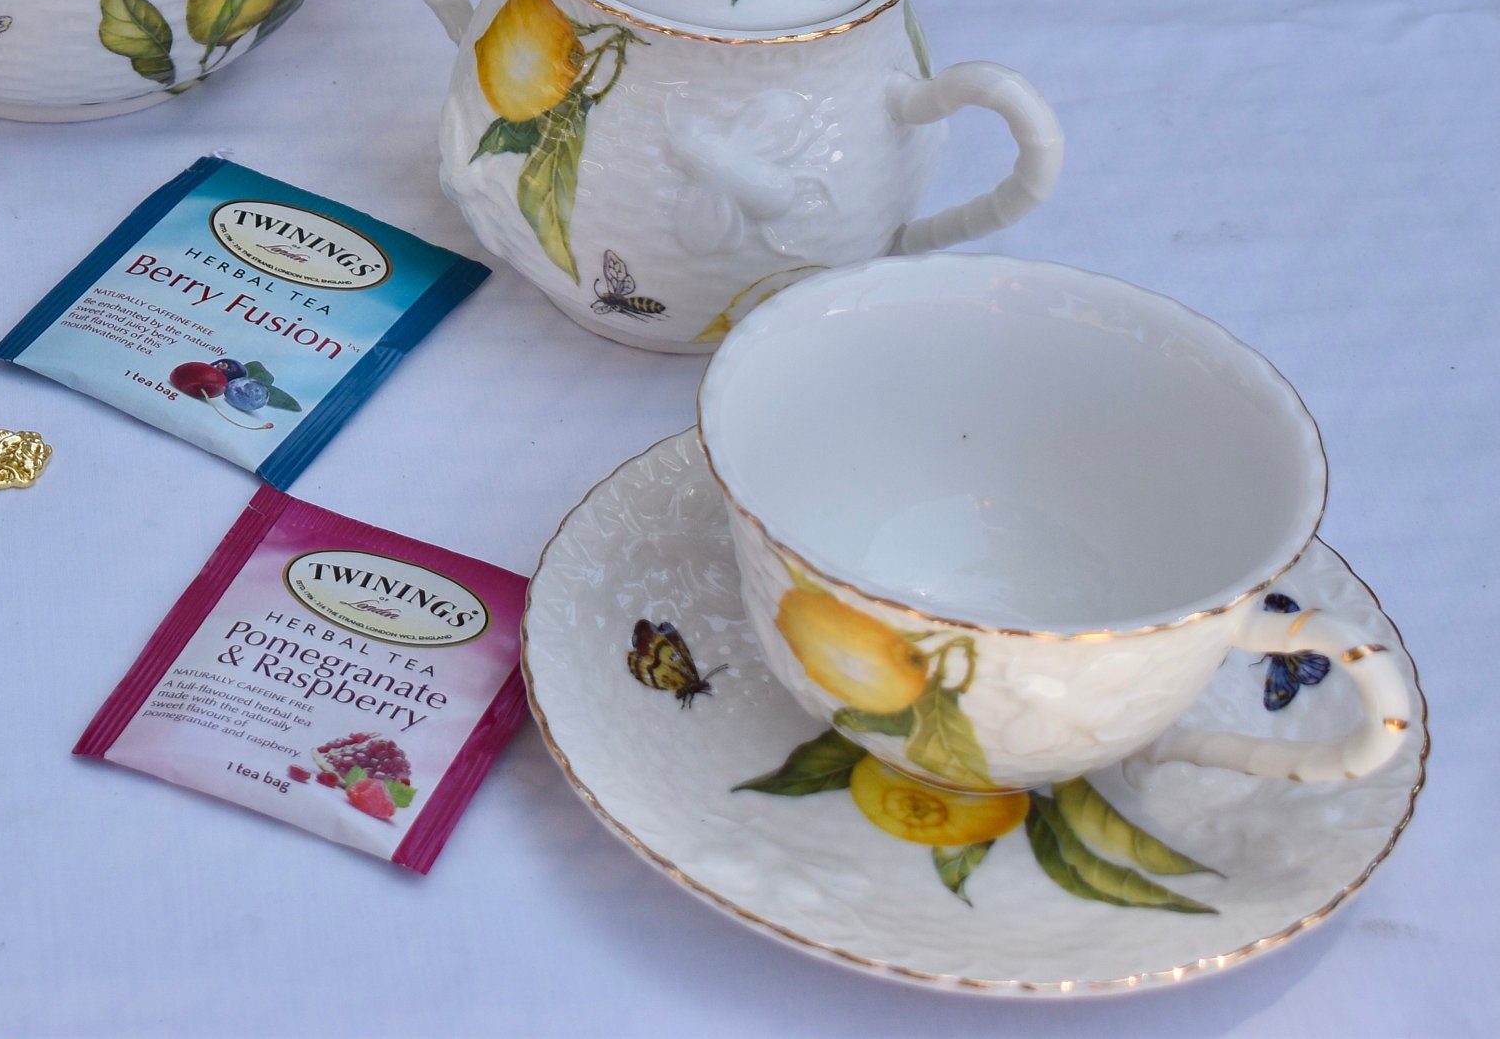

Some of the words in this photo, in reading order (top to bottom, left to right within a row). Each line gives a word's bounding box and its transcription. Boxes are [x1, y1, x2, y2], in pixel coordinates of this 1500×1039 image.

[185, 248, 274, 292] HERBAL
[290, 291, 330, 315] TEA
[68, 311, 89, 321] fruit
[90, 317, 129, 335] flavours
[130, 332, 143, 340] of
[145, 336, 161, 348] this
[76, 305, 105, 317] sweet
[105, 311, 125, 323] and
[125, 318, 149, 332] juicy
[151, 330, 178, 345] berry
[93, 288, 147, 307] NATURALLY
[148, 304, 191, 327] CAFFEINE
[191, 324, 215, 336] FREE
[98, 301, 150, 322] enchanted
[151, 318, 163, 328] by
[165, 325, 182, 336] the
[183, 333, 227, 357] naturally
[125, 254, 224, 306] Berry
[224, 294, 342, 360] Fusion
[61, 320, 134, 348] mouthwatering
[136, 343, 153, 356] tea.
[132, 372, 152, 387] tea
[155, 382, 180, 400] bag
[339, 599, 402, 619] London
[225, 621, 447, 710] Pomegranate
[266, 611, 369, 655] HERBAL
[389, 652, 435, 677] TEA
[173, 668, 235, 686] NATURALLY
[237, 682, 287, 703] CAFFEINE
[288, 698, 316, 713] FREE
[176, 681, 252, 706] full-flavoured
[255, 702, 291, 720] herbal
[293, 715, 311, 727] tea
[217, 644, 245, 666] &
[252, 653, 428, 731] Raspberry
[142, 710, 219, 730] pomegranate
[220, 726, 245, 738] and
[246, 734, 301, 757] raspberry.
[150, 700, 185, 710] sweet
[186, 703, 231, 723] flavours
[234, 718, 249, 727] of
[158, 690, 189, 700] made
[192, 693, 217, 707] with
[220, 702, 239, 713] the
[241, 709, 292, 732] naturally
[227, 761, 233, 770] 1
[236, 763, 260, 780] tea
[263, 771, 292, 794] bag
